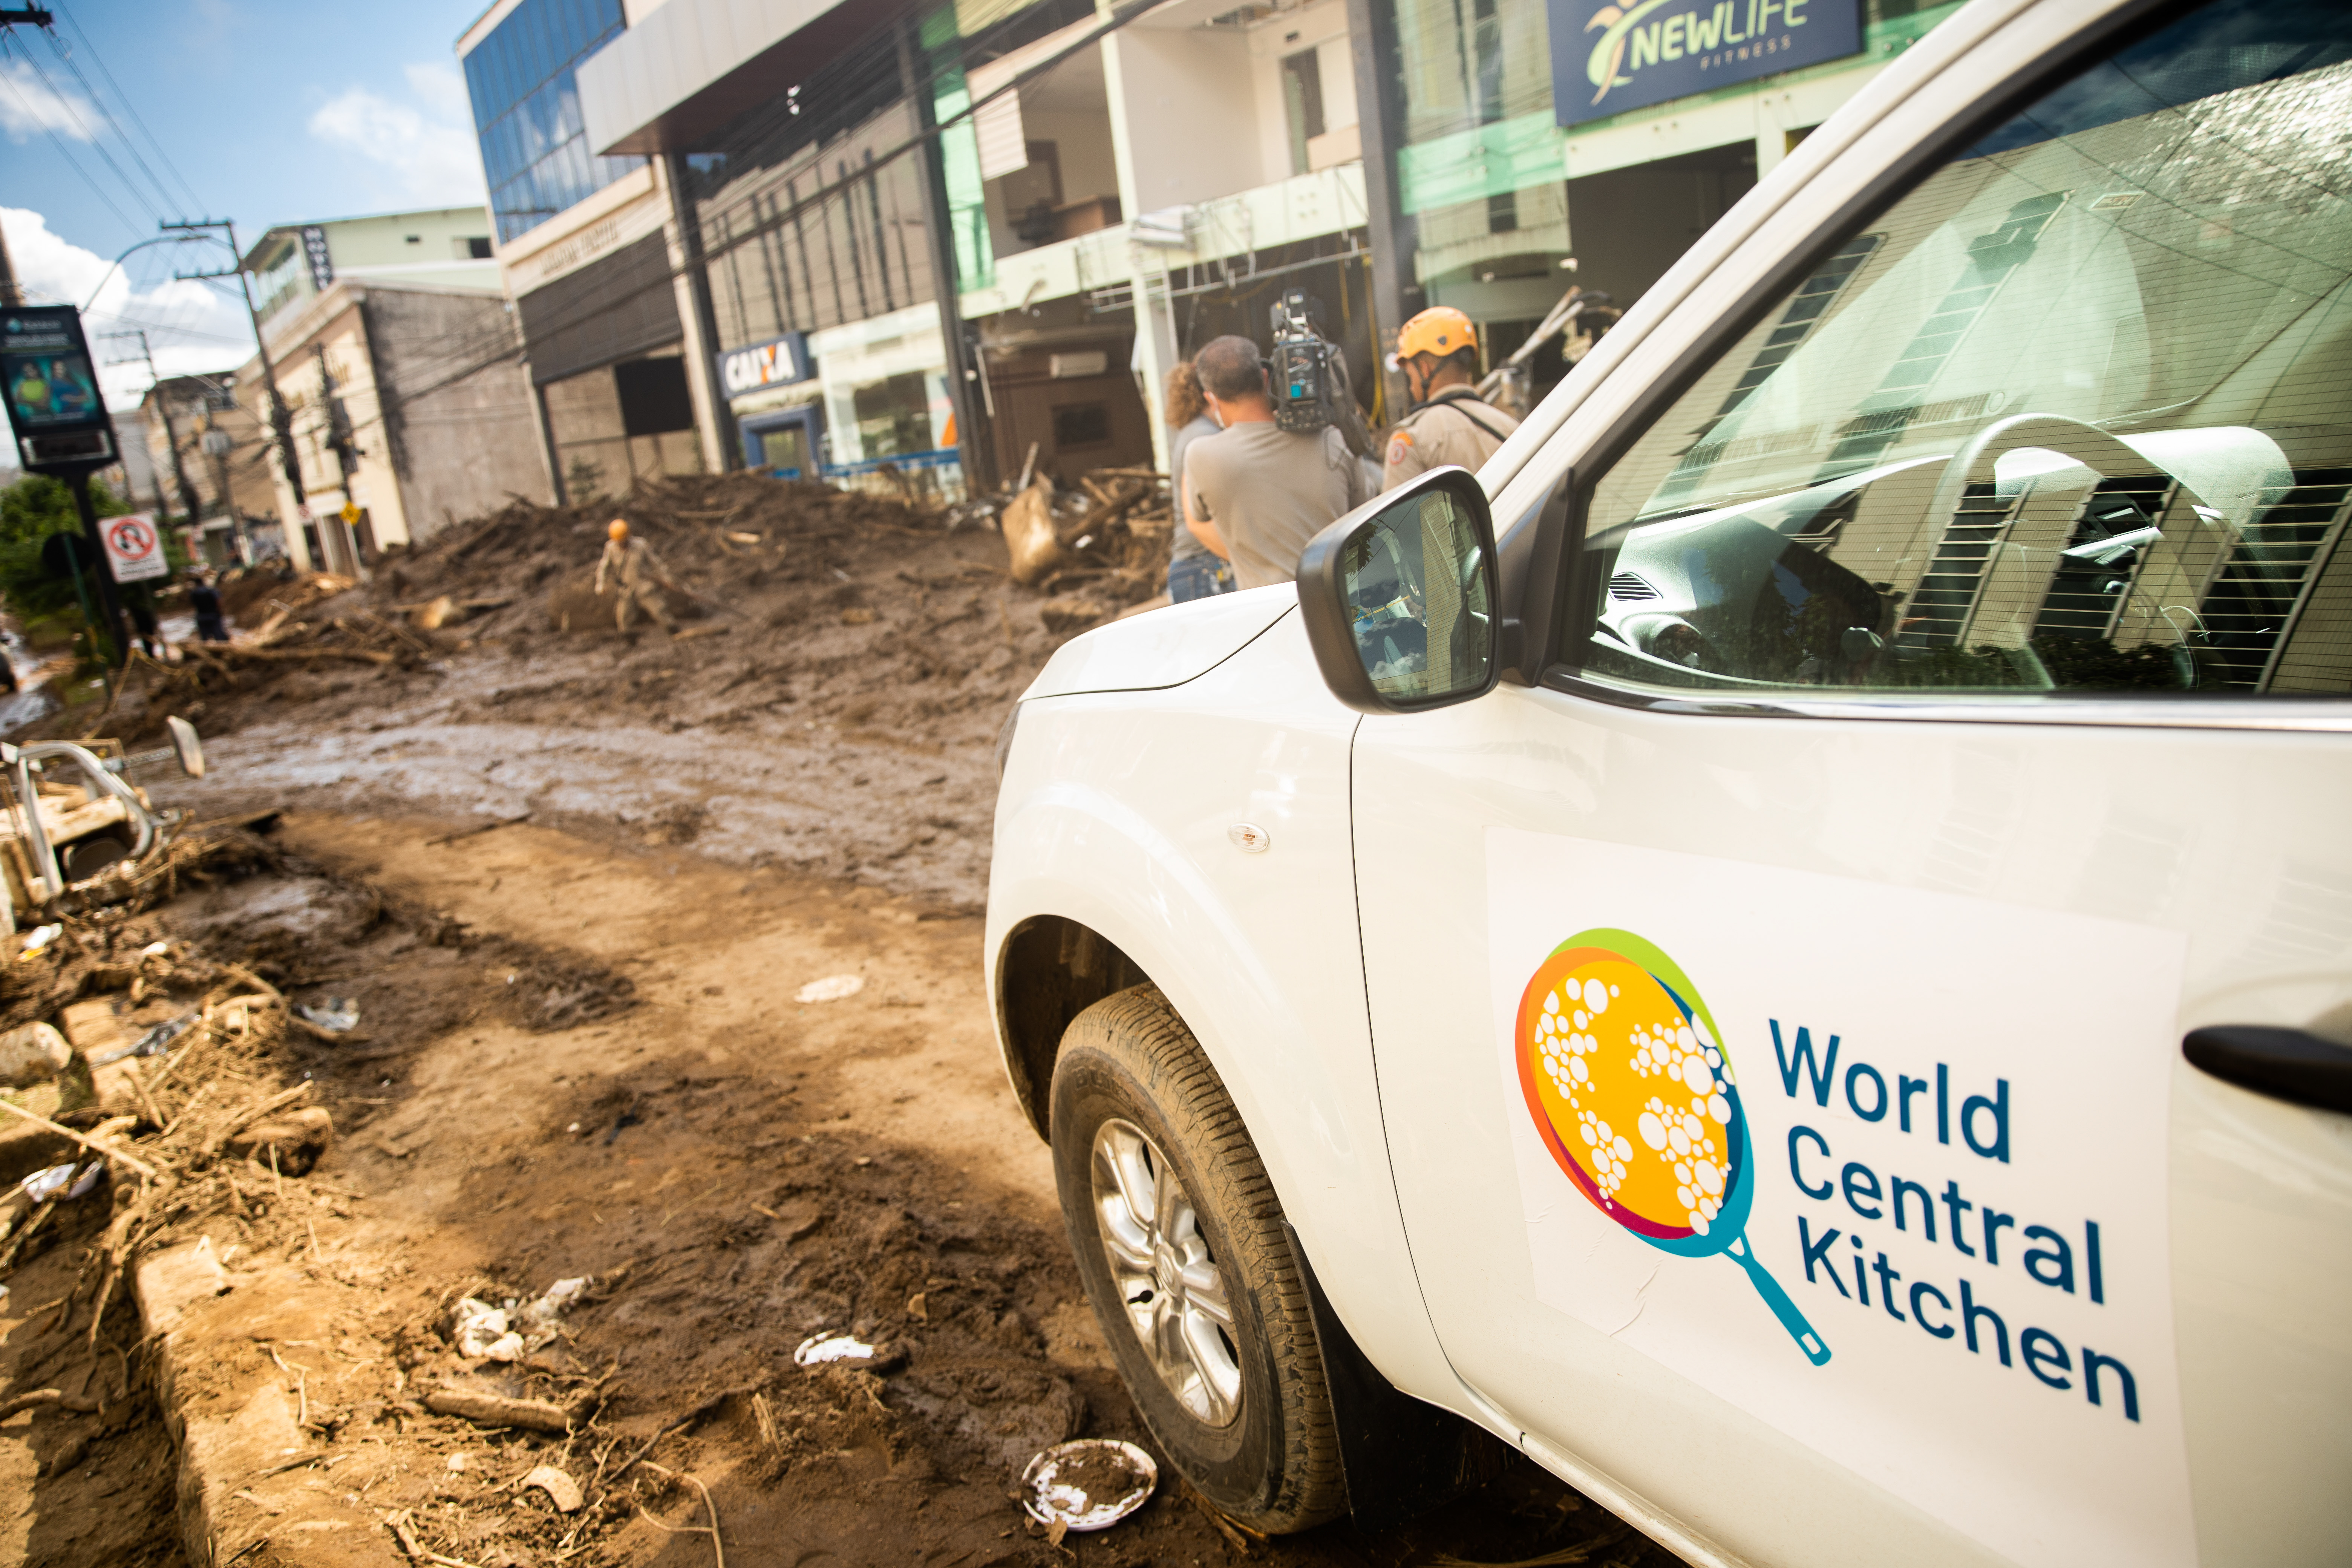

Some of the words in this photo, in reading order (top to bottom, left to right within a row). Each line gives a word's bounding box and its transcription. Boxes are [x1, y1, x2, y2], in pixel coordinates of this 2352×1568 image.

[1700, 34, 1792, 71] FITNESS
[725, 340, 796, 392] CAIXA
[1769, 1018, 2010, 1164] World
[1788, 1125, 2105, 1306] Central
[1798, 1215, 2140, 1424] Kitchen
